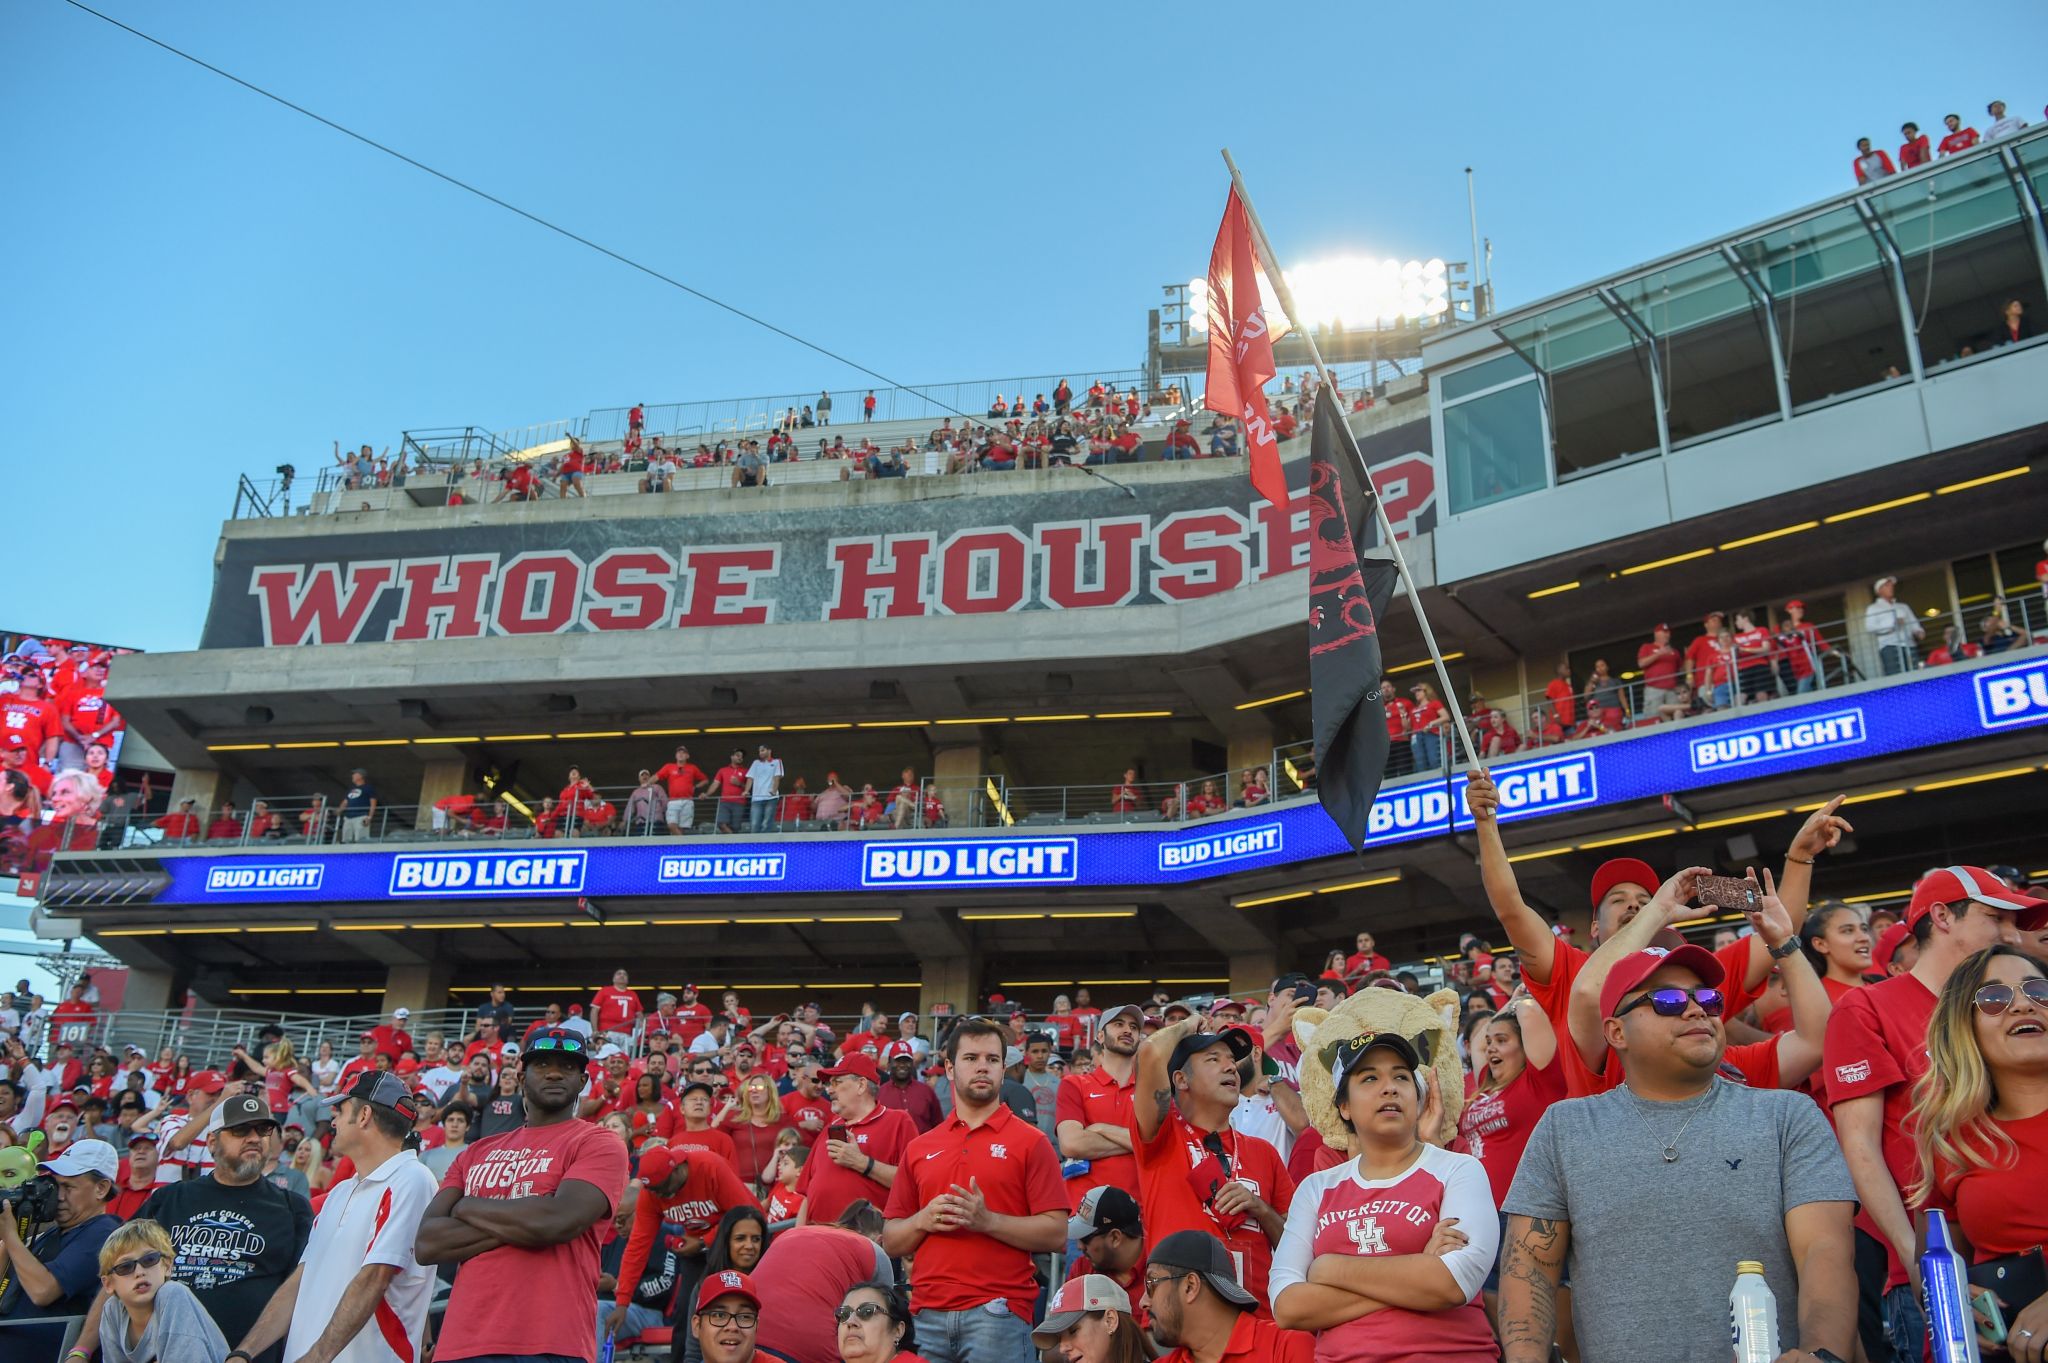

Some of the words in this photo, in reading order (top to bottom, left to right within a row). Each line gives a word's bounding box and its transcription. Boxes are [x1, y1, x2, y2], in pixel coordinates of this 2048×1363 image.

[248, 541, 782, 647] WHOSE
[1699, 737, 1763, 766] BUD
[1764, 714, 1858, 753] LIGHT
[1368, 790, 1456, 834] BUD
[1460, 763, 1586, 816] GHT
[869, 849, 952, 879] BUD
[954, 845, 1070, 876] LIGHT
[1163, 843, 1213, 866] BUD
[1215, 828, 1278, 857] LIGHT
[211, 869, 262, 889] BUD
[262, 867, 319, 887] LIGHT
[396, 859, 472, 889] BUD
[474, 856, 580, 887] LIGHT
[663, 858, 712, 878] BUD
[713, 855, 781, 876] LIGHT
[617, 999, 629, 1018] 7
[61, 1025, 88, 1042] 101
[464, 1157, 554, 1198] HOUSTON
[189, 1210, 217, 1223] NCAA
[219, 1209, 255, 1230] COLLEGE
[1314, 1199, 1409, 1240] UNIVERSITY
[1406, 1204, 1432, 1227] OF
[1346, 1216, 1392, 1254] UH
[170, 1225, 266, 1256] WORLD
[178, 1243, 241, 1260] SERIES
[719, 1271, 743, 1289] UH
